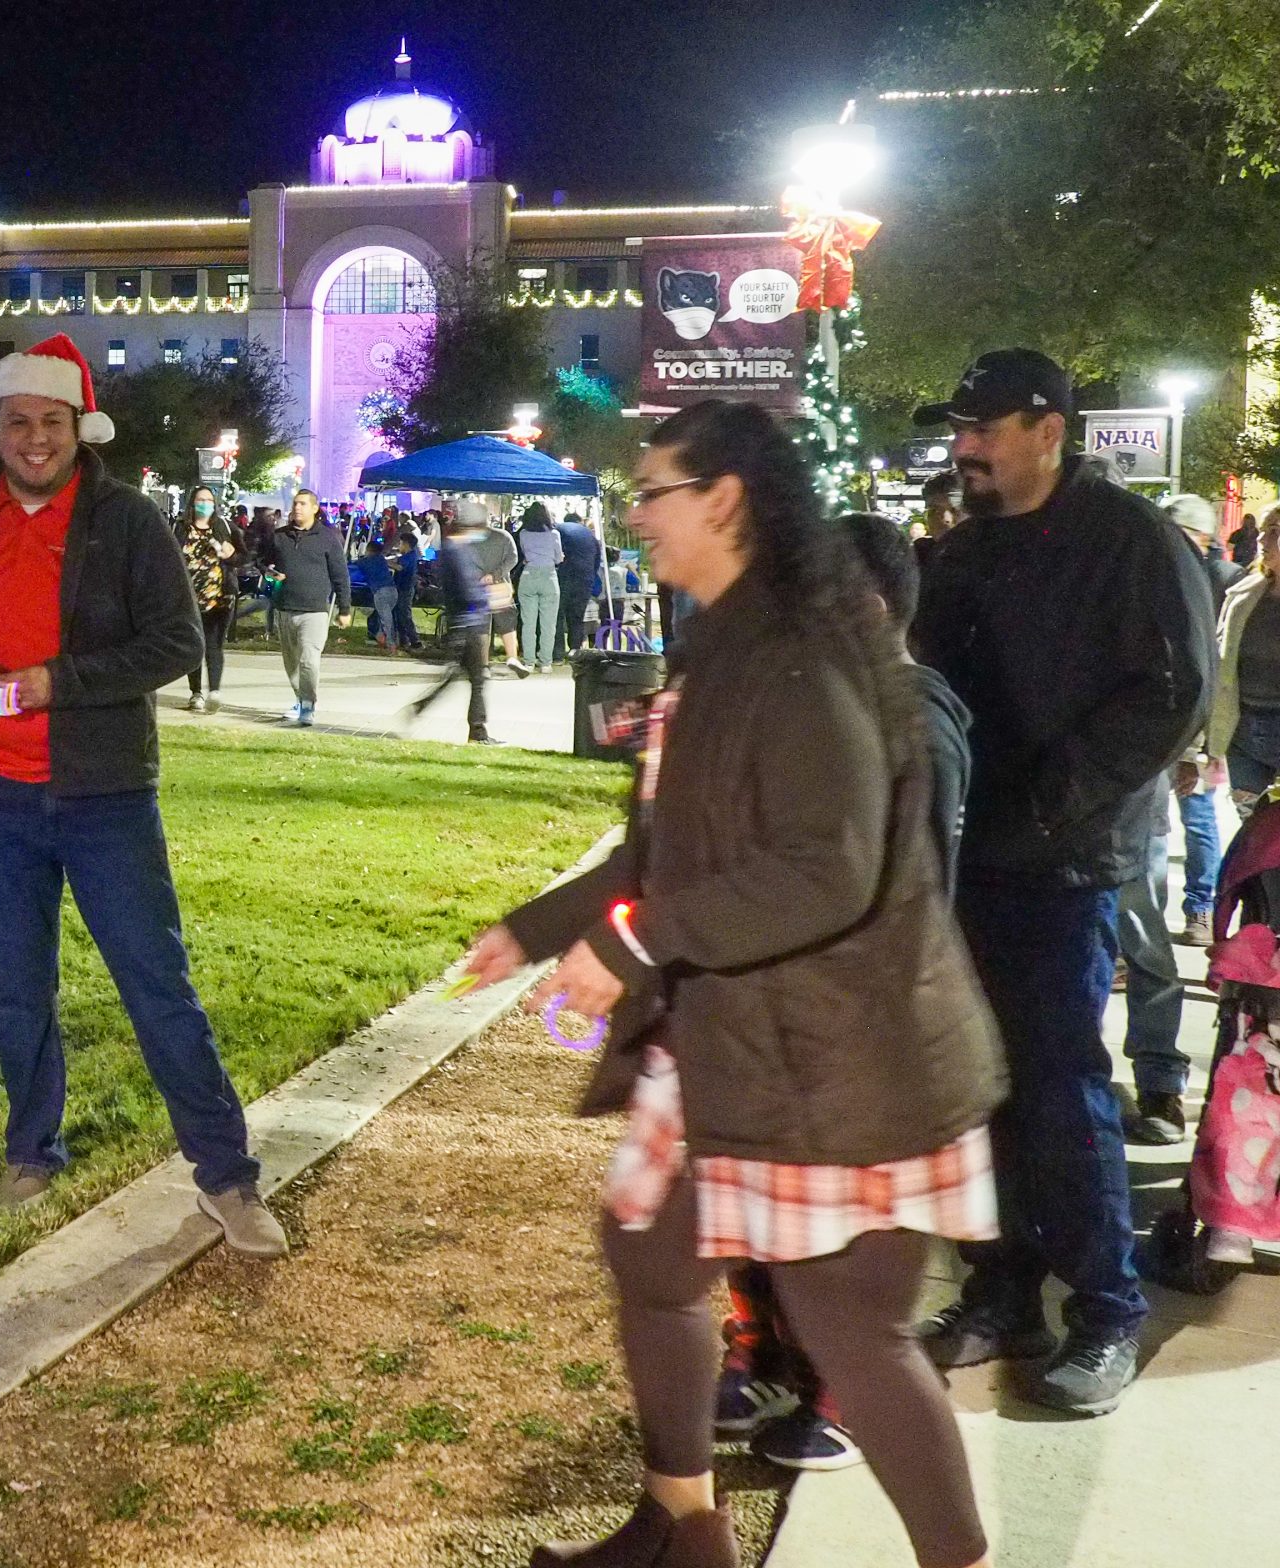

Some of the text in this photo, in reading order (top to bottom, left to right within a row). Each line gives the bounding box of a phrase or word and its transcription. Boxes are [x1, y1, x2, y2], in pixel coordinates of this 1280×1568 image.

[739, 282, 790, 292] YOUR SAFETY
[743, 294, 786, 302] IS OUR TOP
[746, 304, 783, 313] PRIORITY
[653, 347, 794, 360] Community. Safety.
[653, 361, 794, 379] TOGETHER.
[1094, 429, 1158, 452] NAIA
